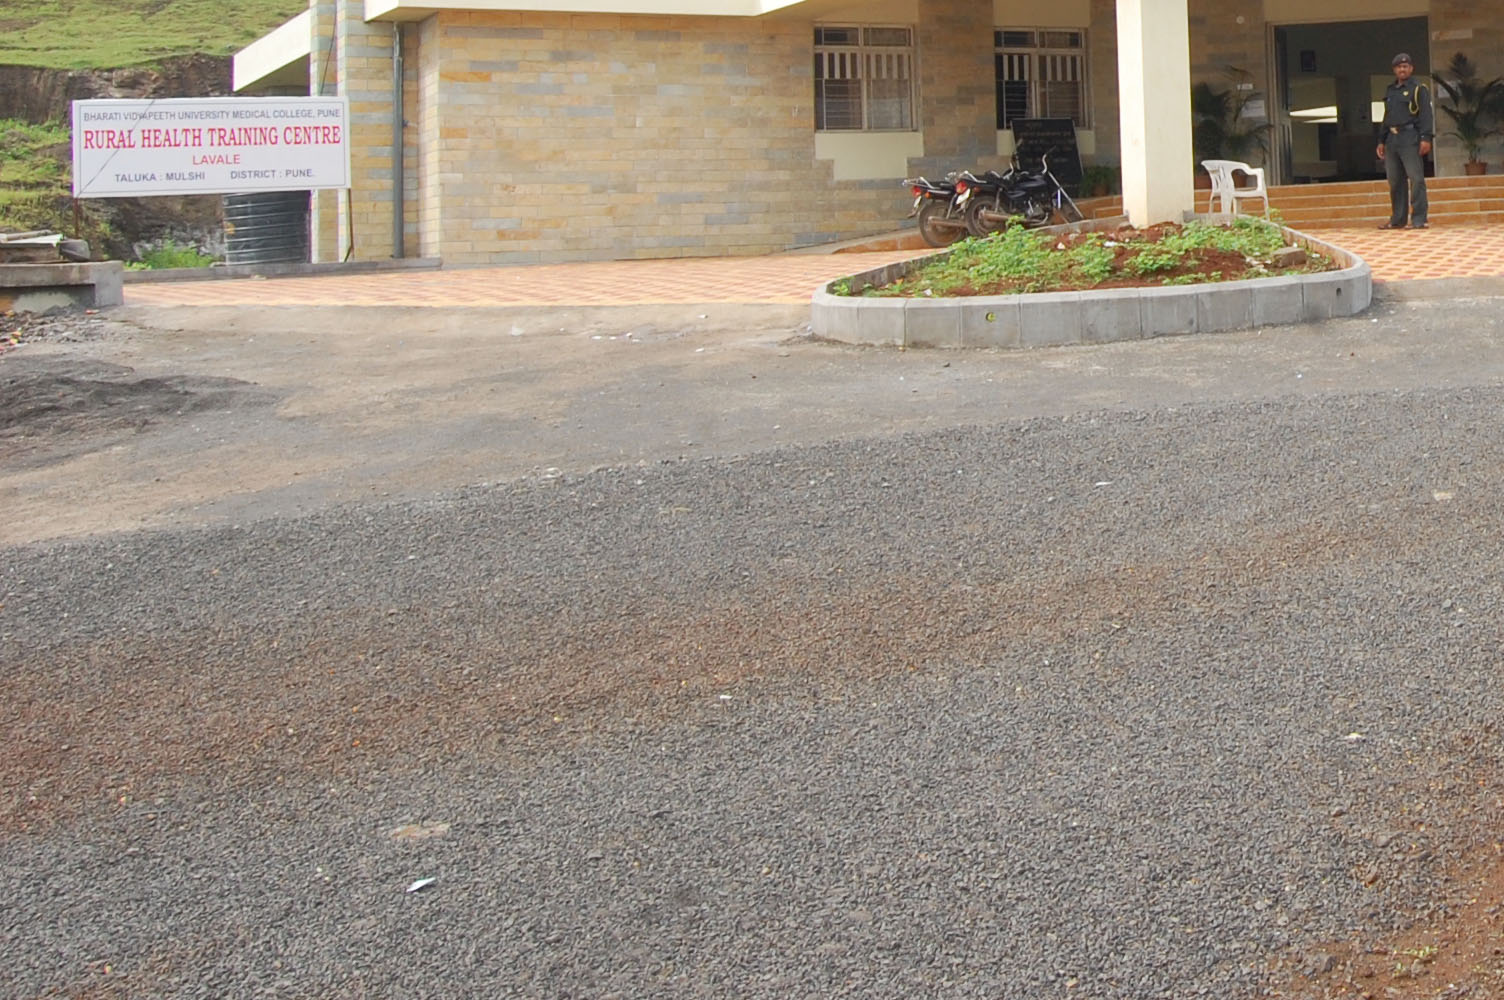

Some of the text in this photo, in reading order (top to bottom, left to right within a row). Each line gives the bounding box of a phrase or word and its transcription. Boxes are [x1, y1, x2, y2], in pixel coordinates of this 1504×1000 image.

[83, 112, 121, 121] BHARATI
[122, 110, 176, 121] VIDYAPEETH
[177, 109, 230, 120] UNIVERSITY
[232, 109, 271, 119] MEDICAL
[317, 108, 341, 118] PUNE
[83, 125, 342, 149] RURAL HEALTH TRAINING CENTRE
[192, 154, 241, 165] LAVALE
[115, 173, 157, 182] TALUKA
[165, 171, 206, 181] MULSHI
[230, 169, 276, 180] DISTRICT
